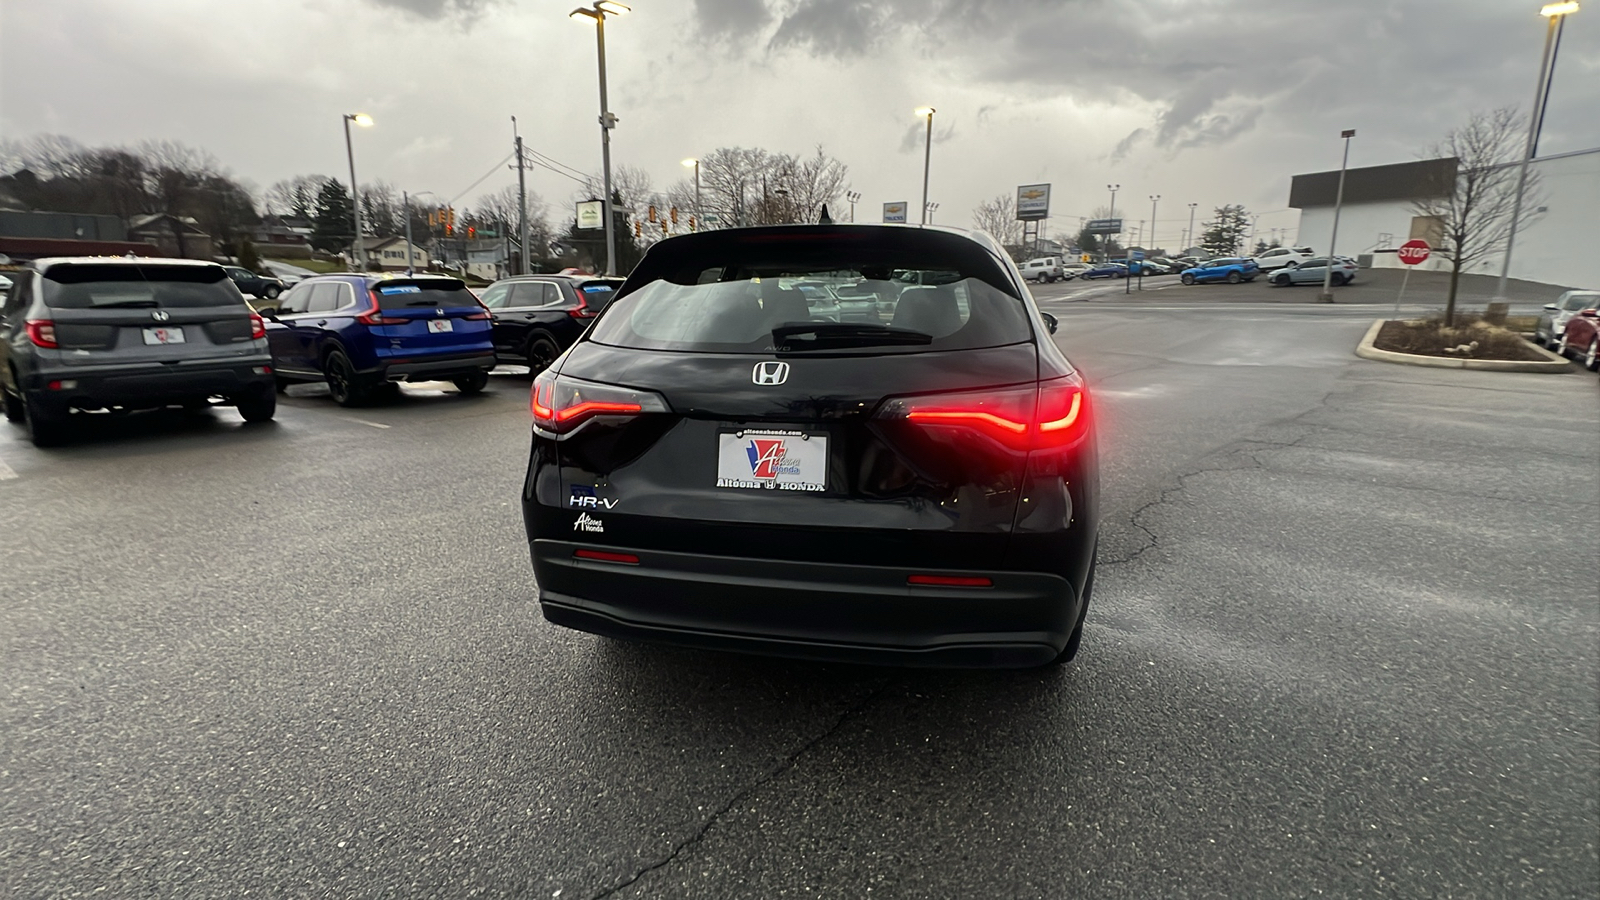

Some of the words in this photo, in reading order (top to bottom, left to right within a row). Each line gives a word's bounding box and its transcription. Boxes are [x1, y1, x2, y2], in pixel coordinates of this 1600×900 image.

[1400, 246, 1428, 258] STOP
[743, 428, 802, 436] altoonahonda.com
[772, 465, 800, 474] Honda
[716, 478, 761, 490] Altoona
[779, 481, 825, 492] HONDA
[569, 495, 619, 509] HR-V
